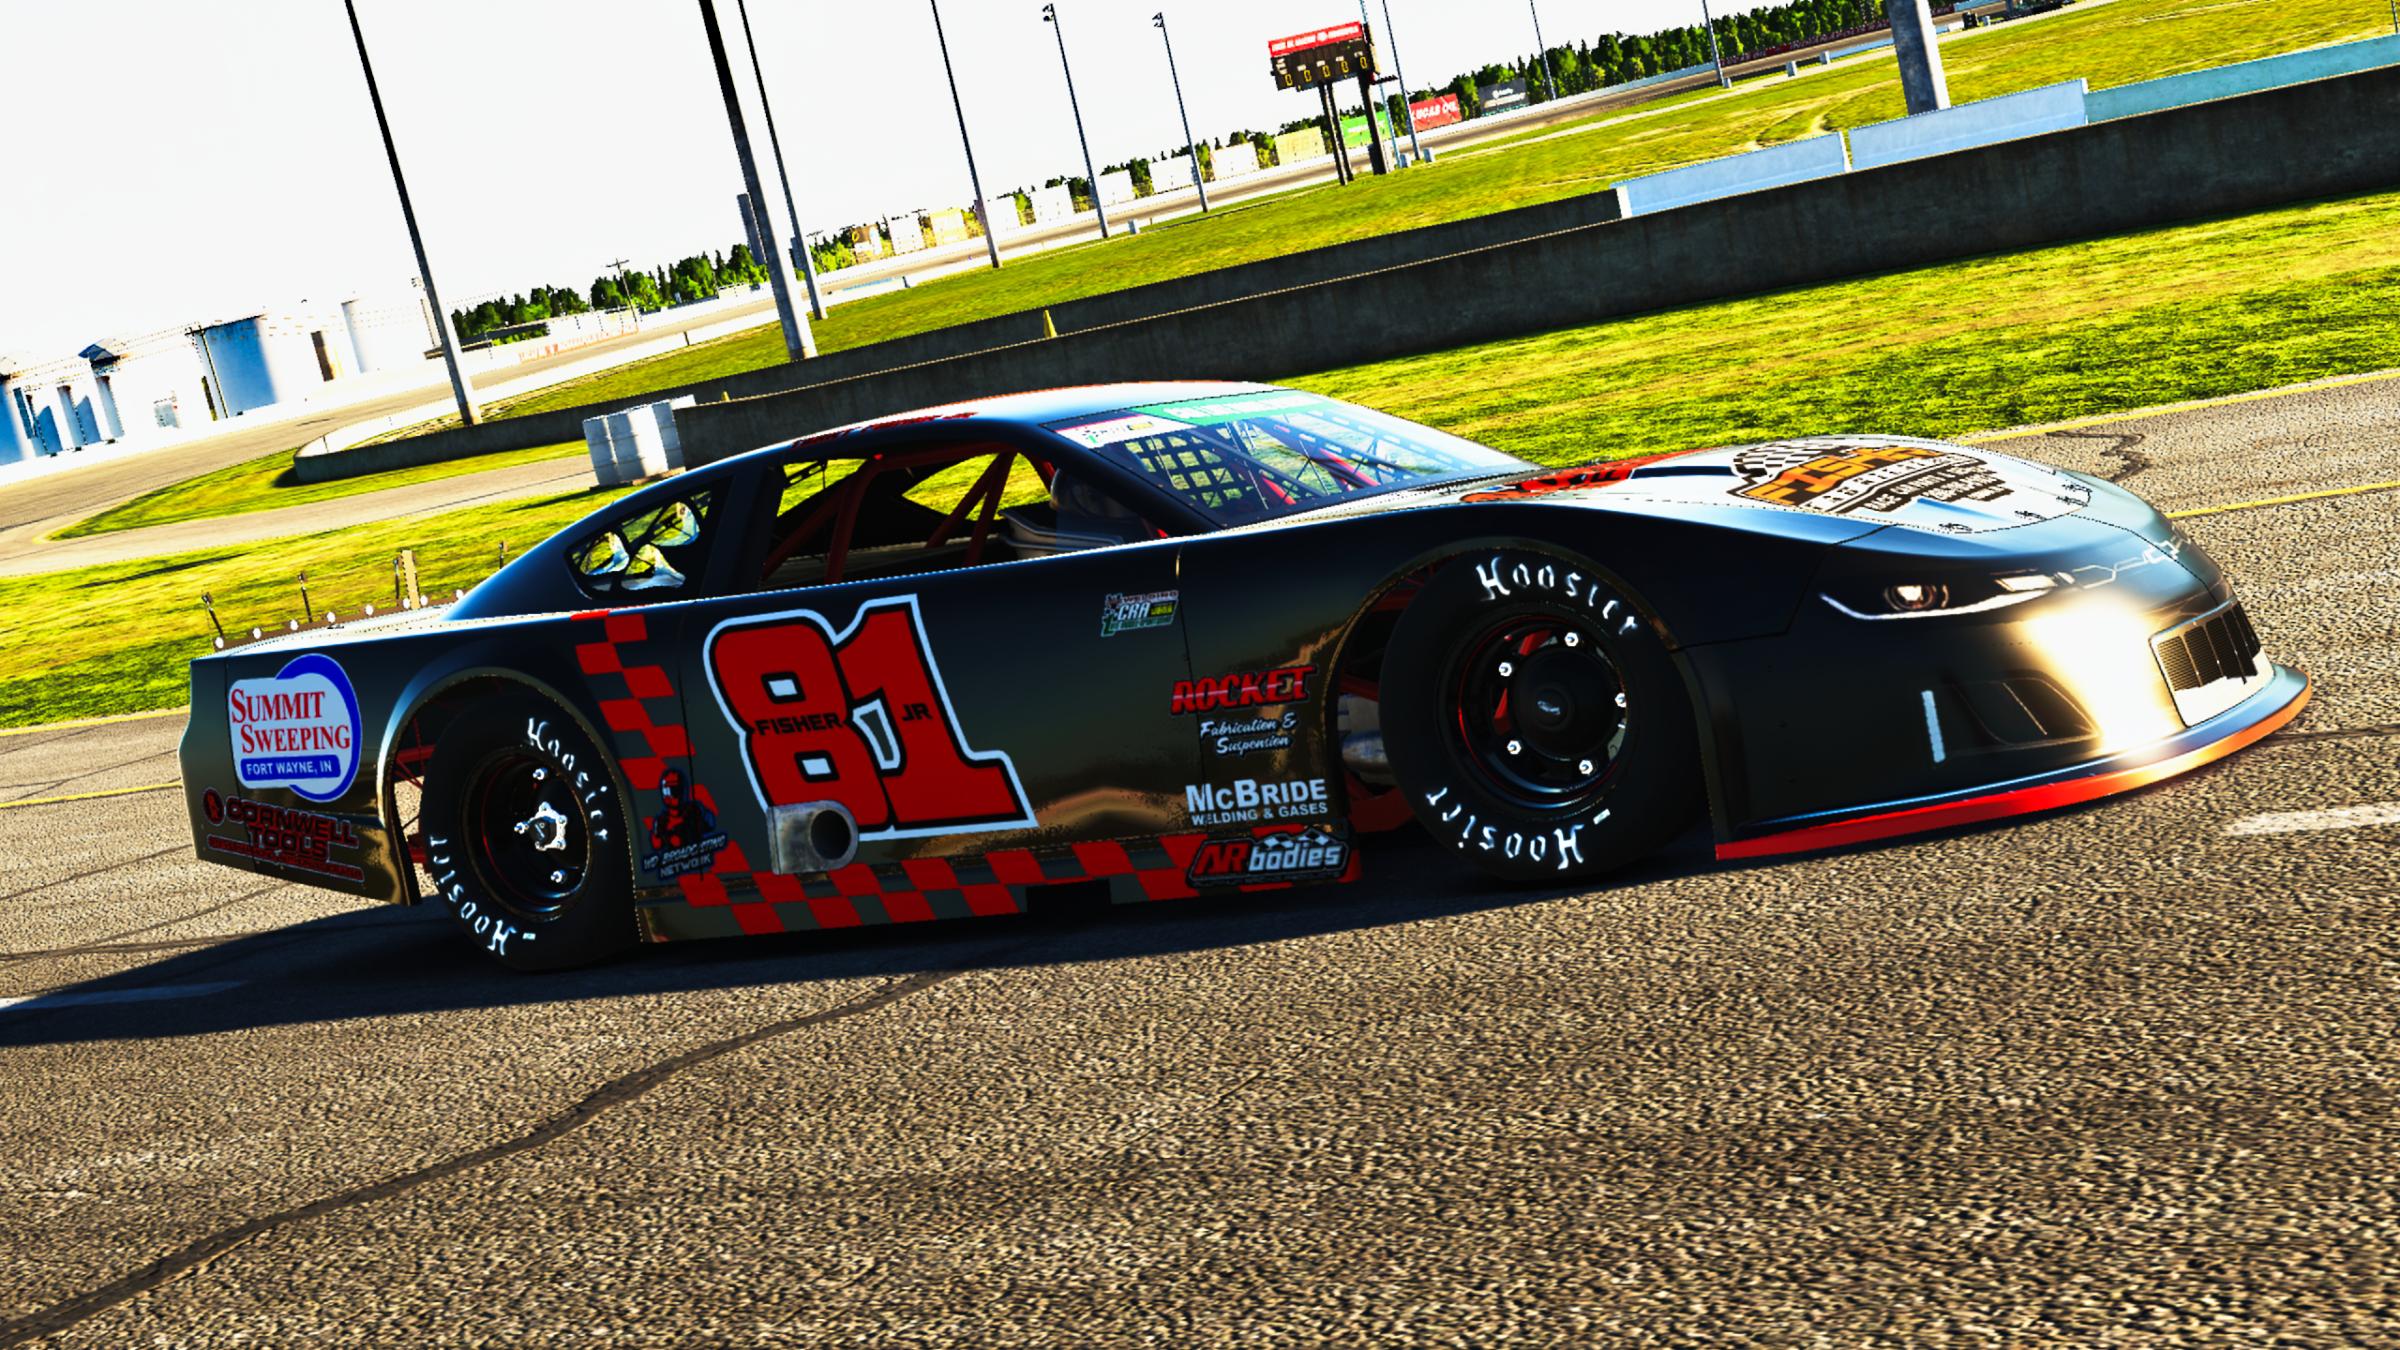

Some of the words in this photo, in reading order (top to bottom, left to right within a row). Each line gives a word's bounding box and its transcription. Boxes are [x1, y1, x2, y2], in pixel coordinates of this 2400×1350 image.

[1118, 601, 1151, 620] CRA
[231, 688, 325, 723] SUMMIT
[1171, 665, 1316, 714] ROCKET
[703, 593, 1039, 842] 81
[755, 712, 842, 736] FISHER
[902, 702, 932, 722] JR
[1200, 718, 1277, 739] Fabrication
[1282, 713, 1297, 729] &
[241, 724, 350, 753] SWEEPING
[1216, 735, 1290, 756] Suspension
[246, 762, 273, 776] FORT
[276, 760, 317, 776] WAYNE,
[320, 760, 332, 772] IN
[527, 717, 609, 841] Hoosier
[226, 797, 359, 848] CORNWELL
[1191, 809, 1258, 826] WELDING
[1263, 808, 1275, 819] &
[1278, 801, 1328, 817] GASES
[249, 825, 329, 864] TOOLS
